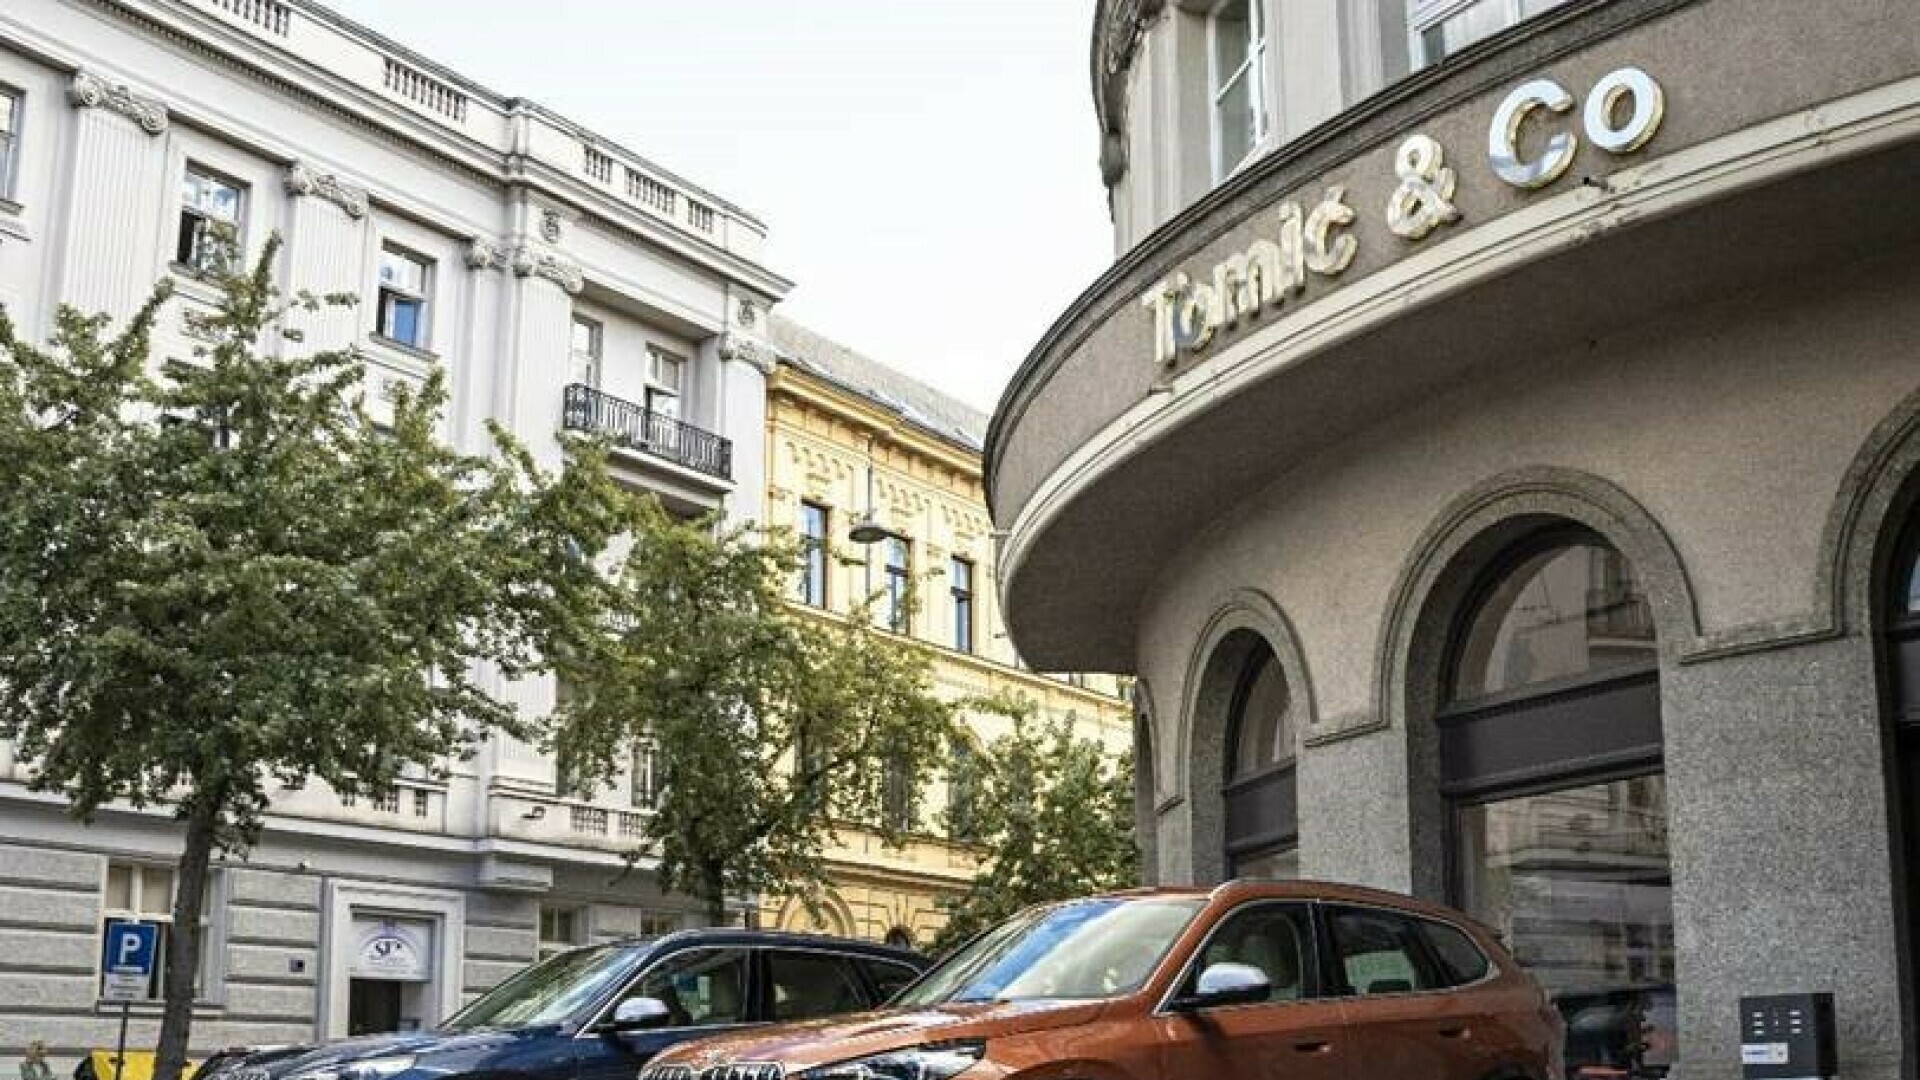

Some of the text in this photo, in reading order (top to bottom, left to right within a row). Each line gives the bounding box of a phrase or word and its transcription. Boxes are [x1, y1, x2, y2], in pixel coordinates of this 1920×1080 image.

[1142, 67, 1664, 365] Tomić & Co
[120, 932, 142, 964] P
